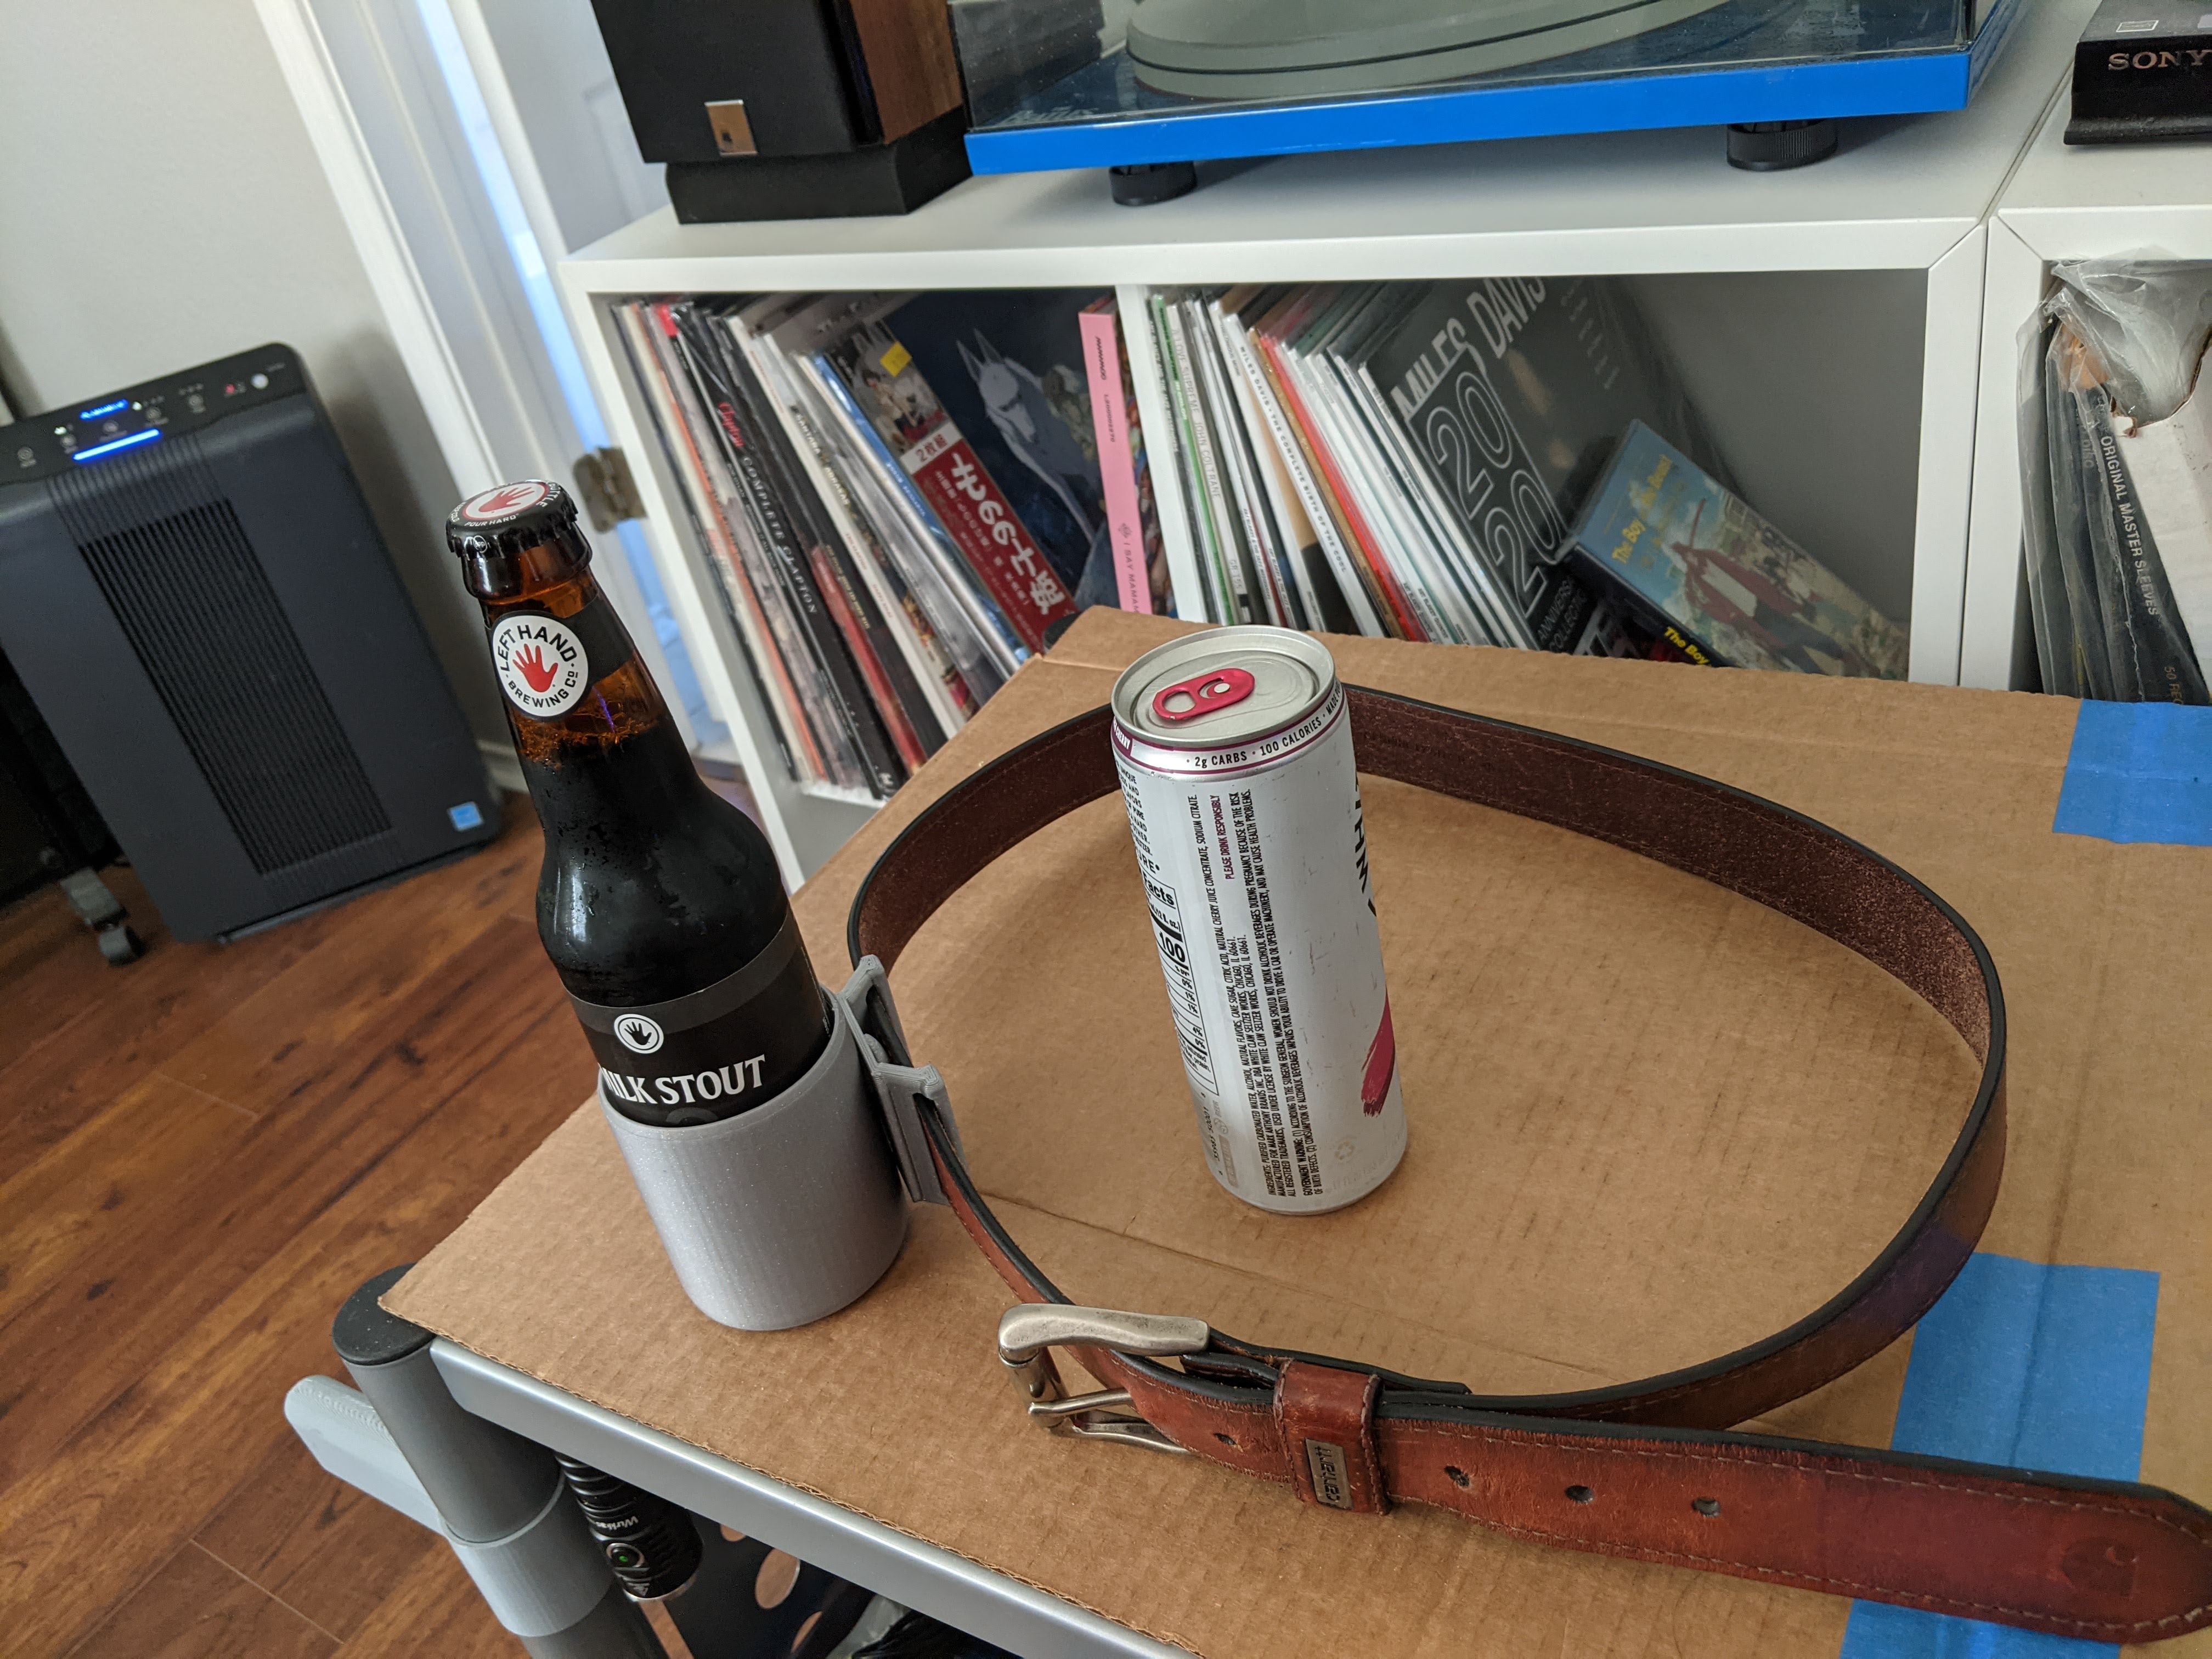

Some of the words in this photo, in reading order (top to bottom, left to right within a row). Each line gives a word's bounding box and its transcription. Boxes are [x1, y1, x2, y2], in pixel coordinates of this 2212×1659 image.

[2108, 49, 2212, 71] SONY
[1170, 327, 1179, 335] A
[1172, 337, 1186, 362] LOVE
[1390, 318, 1487, 422] MILES
[1180, 366, 1199, 414] SUPREME
[793, 413, 823, 455] SANTANA
[1193, 420, 1207, 446] JOHN
[1426, 372, 1513, 520] 20
[1239, 346, 1257, 376] MILES
[1253, 378, 1271, 407] DAVIS
[1269, 414, 1282, 432] THE
[1279, 435, 1305, 483] COMPLETE
[1302, 484, 1319, 512] BIRTH
[1317, 515, 1327, 528] OF
[1323, 529, 1335, 548] THE
[1333, 549, 1347, 573] COOL
[1200, 449, 1221, 500] COLTRANE
[740, 454, 786, 541] COMPLETE
[780, 544, 819, 616] CLAPTON
[951, 452, 1066, 616] もののけ姫
[2098, 434, 2130, 500] ORIGINAL
[2116, 501, 2145, 558] MASTER
[2132, 558, 2160, 617] SLEEVES
[1485, 470, 1564, 619] 20
[498, 628, 517, 673] LEFT
[517, 624, 577, 663] HAND
[1662, 625, 1688, 650] The
[1684, 643, 1710, 668] Boy
[508, 680, 569, 709] BREWING
[1115, 726, 1131, 750] CHERRY
[1195, 757, 1207, 768] 2g
[1211, 751, 1247, 766] CARBS
[1260, 741, 1279, 756] 100
[1282, 716, 1322, 747] CALORIES
[1325, 696, 1339, 715] MADE
[1128, 784, 1139, 797] AND
[1228, 792, 1240, 805] RISK
[1133, 808, 1145, 821] PURE
[1187, 794, 1200, 819] CITRATE.
[1210, 794, 1226, 836] RESPONSIBLY
[1231, 806, 1243, 818] THE
[1240, 788, 1255, 821] PROBLEMS.
[1133, 817, 1148, 833] HARD
[1193, 820, 1205, 844] SODIUM
[1246, 822, 1259, 843] HEALTH
[1218, 837, 1229, 855] DRINK
[1235, 827, 1249, 853] BECAUSE
[1250, 845, 1262, 863] CAUSE
[1198, 846, 1215, 886] CONCENTRATE,
[1221, 856, 1234, 879] PLEASE
[1240, 854, 1255, 885] PREGNANCY
[1254, 864, 1265, 876] MAY
[1143, 872, 1175, 906] Facts
[1256, 877, 1267, 888] AND
[1206, 887, 1217, 903] JUICE
[1246, 887, 1259, 907] DURING
[1258, 890, 1274, 921] MACHINERY,
[1209, 904, 1222, 925] CHERRY
[1250, 909, 1265, 939] BEVERAGES
[1214, 927, 1226, 950] NATURAL
[1264, 922, 1277, 946] OPERATE
[1159, 931, 1186, 963] 100
[1226, 936, 1238, 956] 60661.
[1256, 940, 1270, 967] ALCOHOLIC
[1219, 952, 1231, 966] ACID,
[1270, 955, 1281, 966] CAR
[1222, 966, 1233, 983] CITRIC
[1232, 964, 1245, 988] CHICAGO,
[1261, 968, 1273, 984] DRINK
[1273, 970, 1284, 986] DRIVE
[1226, 985, 1239, 1003] SUGAR,
[1237, 990, 1250, 1010] WORKS,
[1265, 986, 1275, 995] NOT
[1229, 1005, 1240, 1018] CANE
[1267, 997, 1279, 1017] SHOULD
[1278, 996, 1290, 1013] ABILITY
[1233, 1019, 1246, 1042] FLAVORS,
[1241, 1012, 1254, 1032] SELTZER
[1271, 1018, 1283, 1037] WOMEN
[1281, 1014, 1292, 1028] YOUR
[1245, 1034, 1256, 1047] CLAW
[1274, 1039, 1289, 1060] GENERAL,
[1284, 1029, 1296, 1049] IMPAIRS
[1238, 1044, 1250, 1066] NATURAL
[1248, 1049, 1260, 1065] WHITE
[1288, 1050, 1301, 1077] BEVERAGES
[655, 1054, 765, 1104] STOUT
[1243, 1068, 1256, 1091] ALCOHOL,
[1252, 1066, 1262, 1077] DBA
[1279, 1062, 1291, 1084] SURGEON
[1248, 1092, 1260, 1109] WATER,
[1257, 1090, 1268, 1109] BRANDS
[1283, 1086, 1294, 1094] THE
[1293, 1077, 1306, 1103] ALCOHOLIC
[1251, 1110, 1265, 1141] CARBONATED
[1261, 1110, 1273, 1133] ANTHONY
[1287, 1103, 1300, 1128] ACCORDING
[1299, 1111, 1313, 1144] CONSUMPTION
[1257, 1142, 1269, 1163] PURIFIED
[1266, 1135, 1276, 1148] MARK
[1293, 1137, 1306, 1162] WARNING:
[1269, 1149, 1278, 1158] FOR
[1307, 1153, 1319, 1172] DEFECTS.
[1262, 1164, 1276, 1195] INGREDIENTS:
[1271, 1160, 1286, 1196] MANUFACTURED
[1298, 1164, 1313, 1195] GOVERNMENT
[1311, 1174, 1321, 1187] BIRTH
